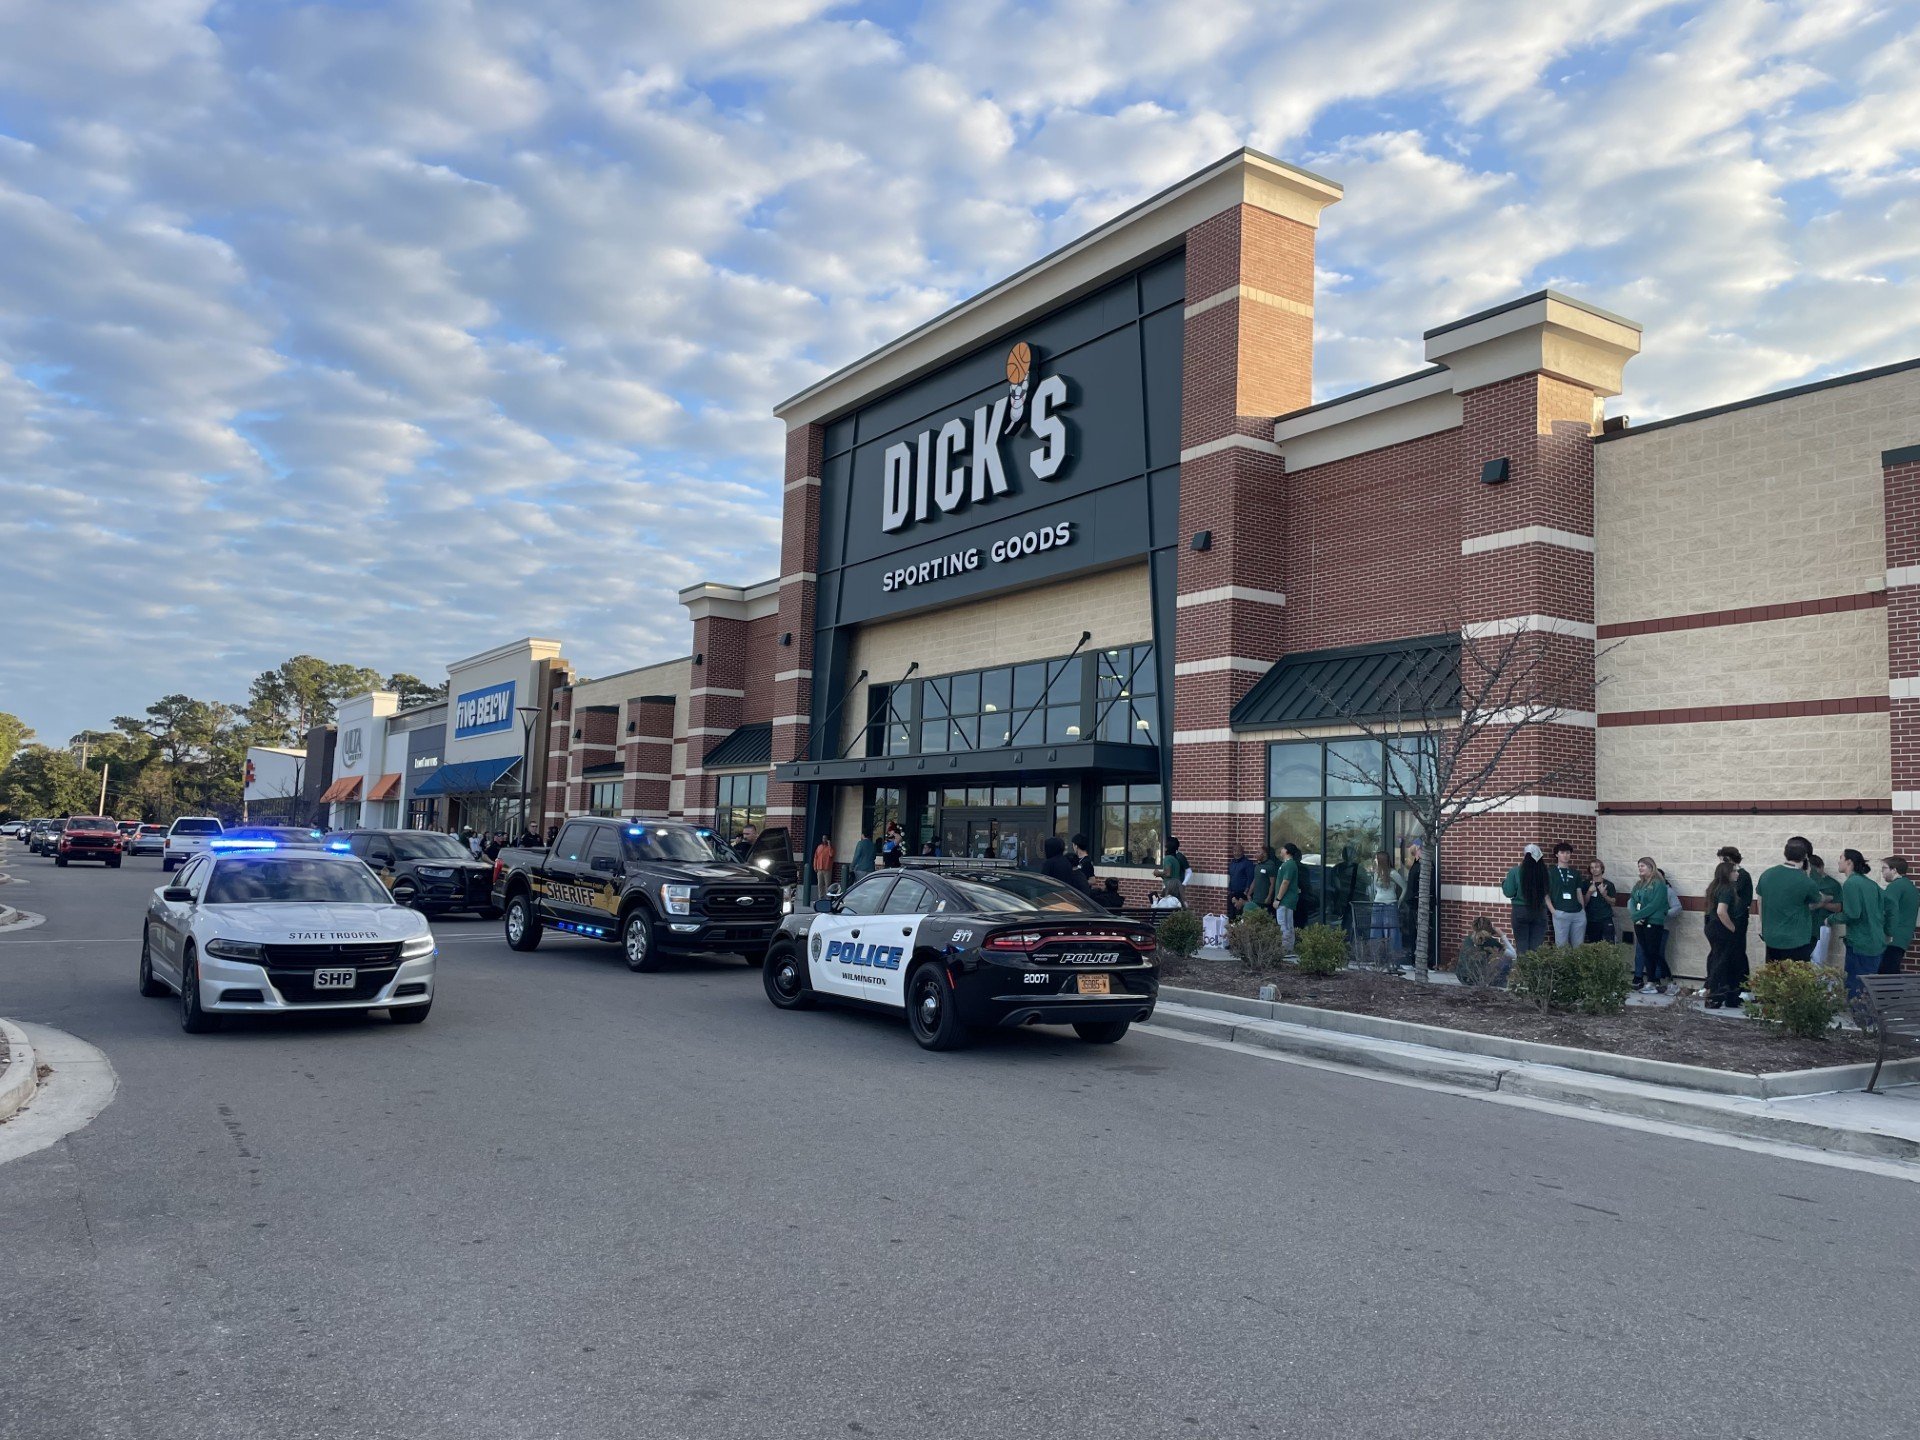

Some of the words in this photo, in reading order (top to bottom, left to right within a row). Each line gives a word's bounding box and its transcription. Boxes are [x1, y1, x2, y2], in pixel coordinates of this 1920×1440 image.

[882, 341, 1067, 533] DICK'S
[882, 548, 979, 592] SPORTING
[990, 522, 1070, 563] GOODS
[546, 881, 596, 907] SHERIFF
[289, 932, 326, 940] STATE
[330, 931, 379, 939] TROOPER
[951, 932, 973, 942] 911
[825, 940, 904, 971] POLICE
[1059, 952, 1120, 964] POLICE
[317, 972, 353, 986] SHP
[842, 972, 887, 986] WILMINGTON
[1023, 973, 1050, 984] 20071
